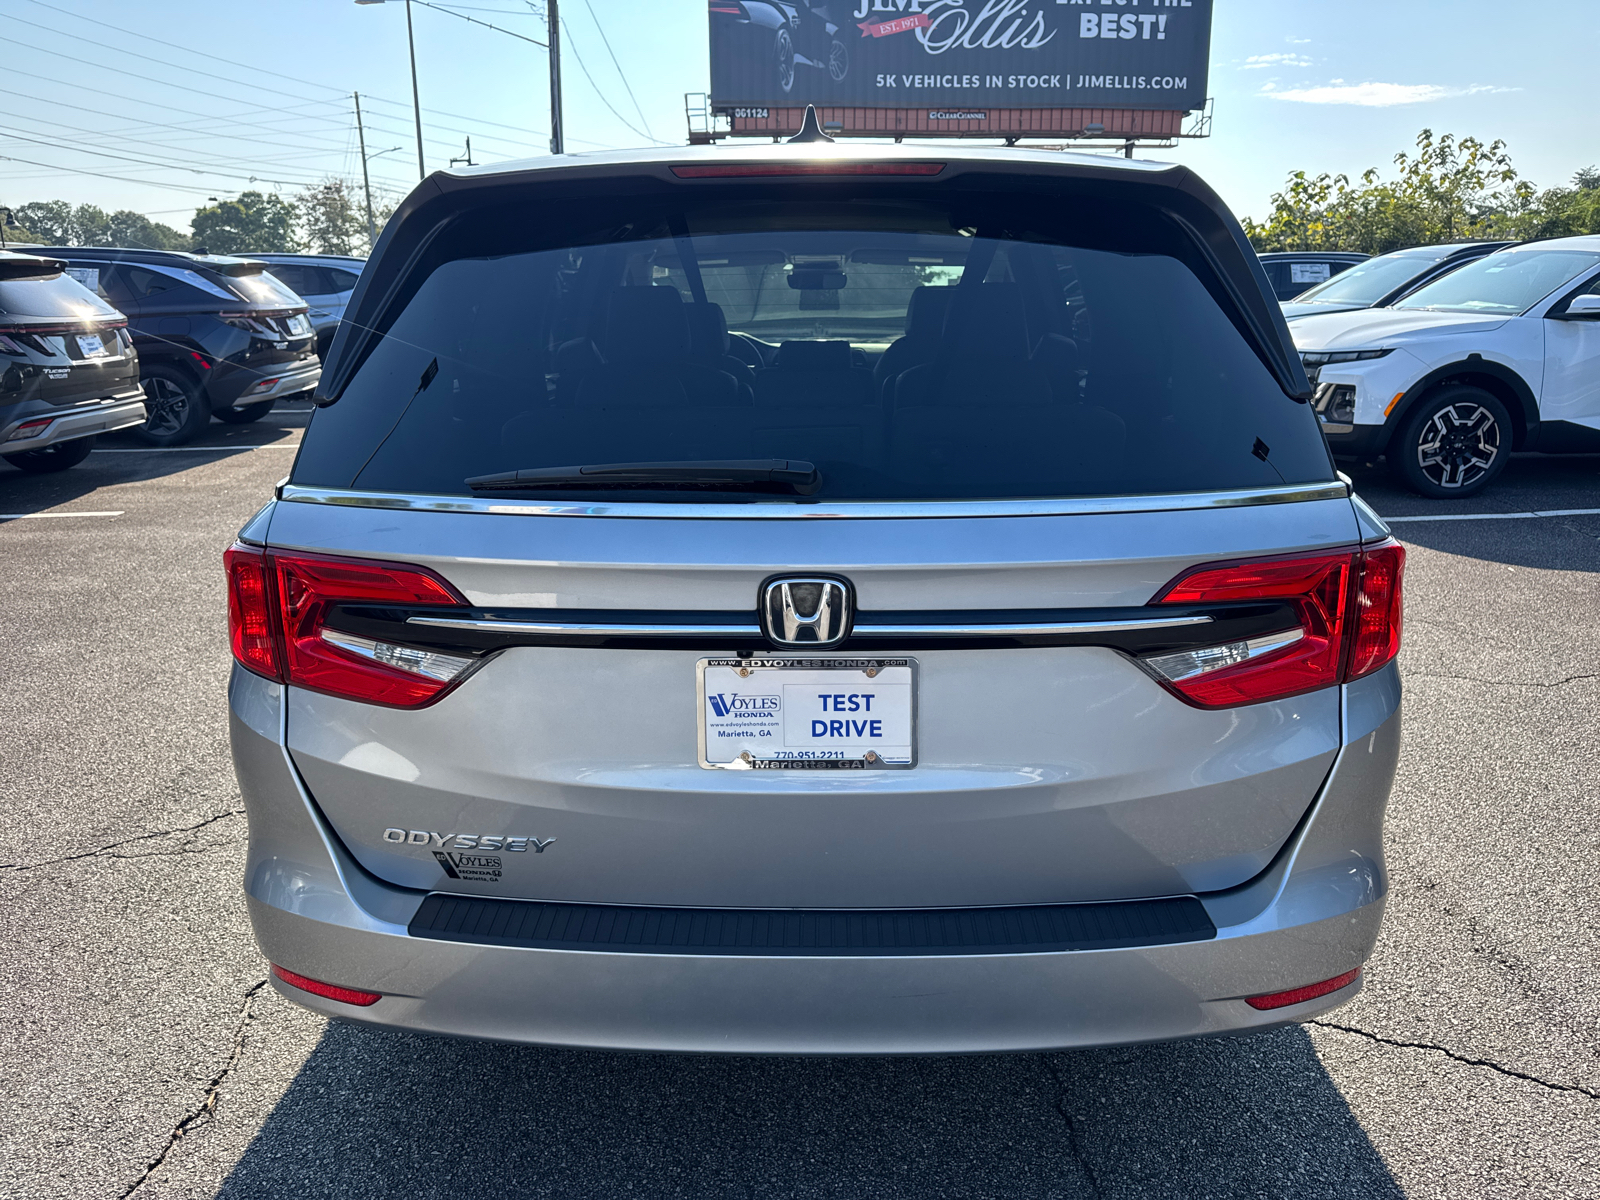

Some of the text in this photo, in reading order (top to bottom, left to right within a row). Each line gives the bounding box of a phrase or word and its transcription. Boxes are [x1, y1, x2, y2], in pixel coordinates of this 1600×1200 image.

[879, 17, 919, 34] EST. 1971
[1079, 12, 1168, 40] BEST!
[876, 74, 897, 88] 5K
[902, 74, 980, 88] VEHICLES
[985, 75, 1003, 88] IN
[1008, 75, 1061, 88] STOCK
[1076, 75, 1187, 90] JIMELLIS.COM
[716, 693, 778, 715] VOYLES
[818, 693, 875, 712] TEST
[717, 730, 756, 738] Marietta,
[811, 719, 883, 738] DRIVE
[774, 751, 844, 759] 770-951-2211
[838, 760, 862, 769] GA
[382, 827, 557, 854] ODYSSEY
[446, 851, 500, 869] VOYLES
